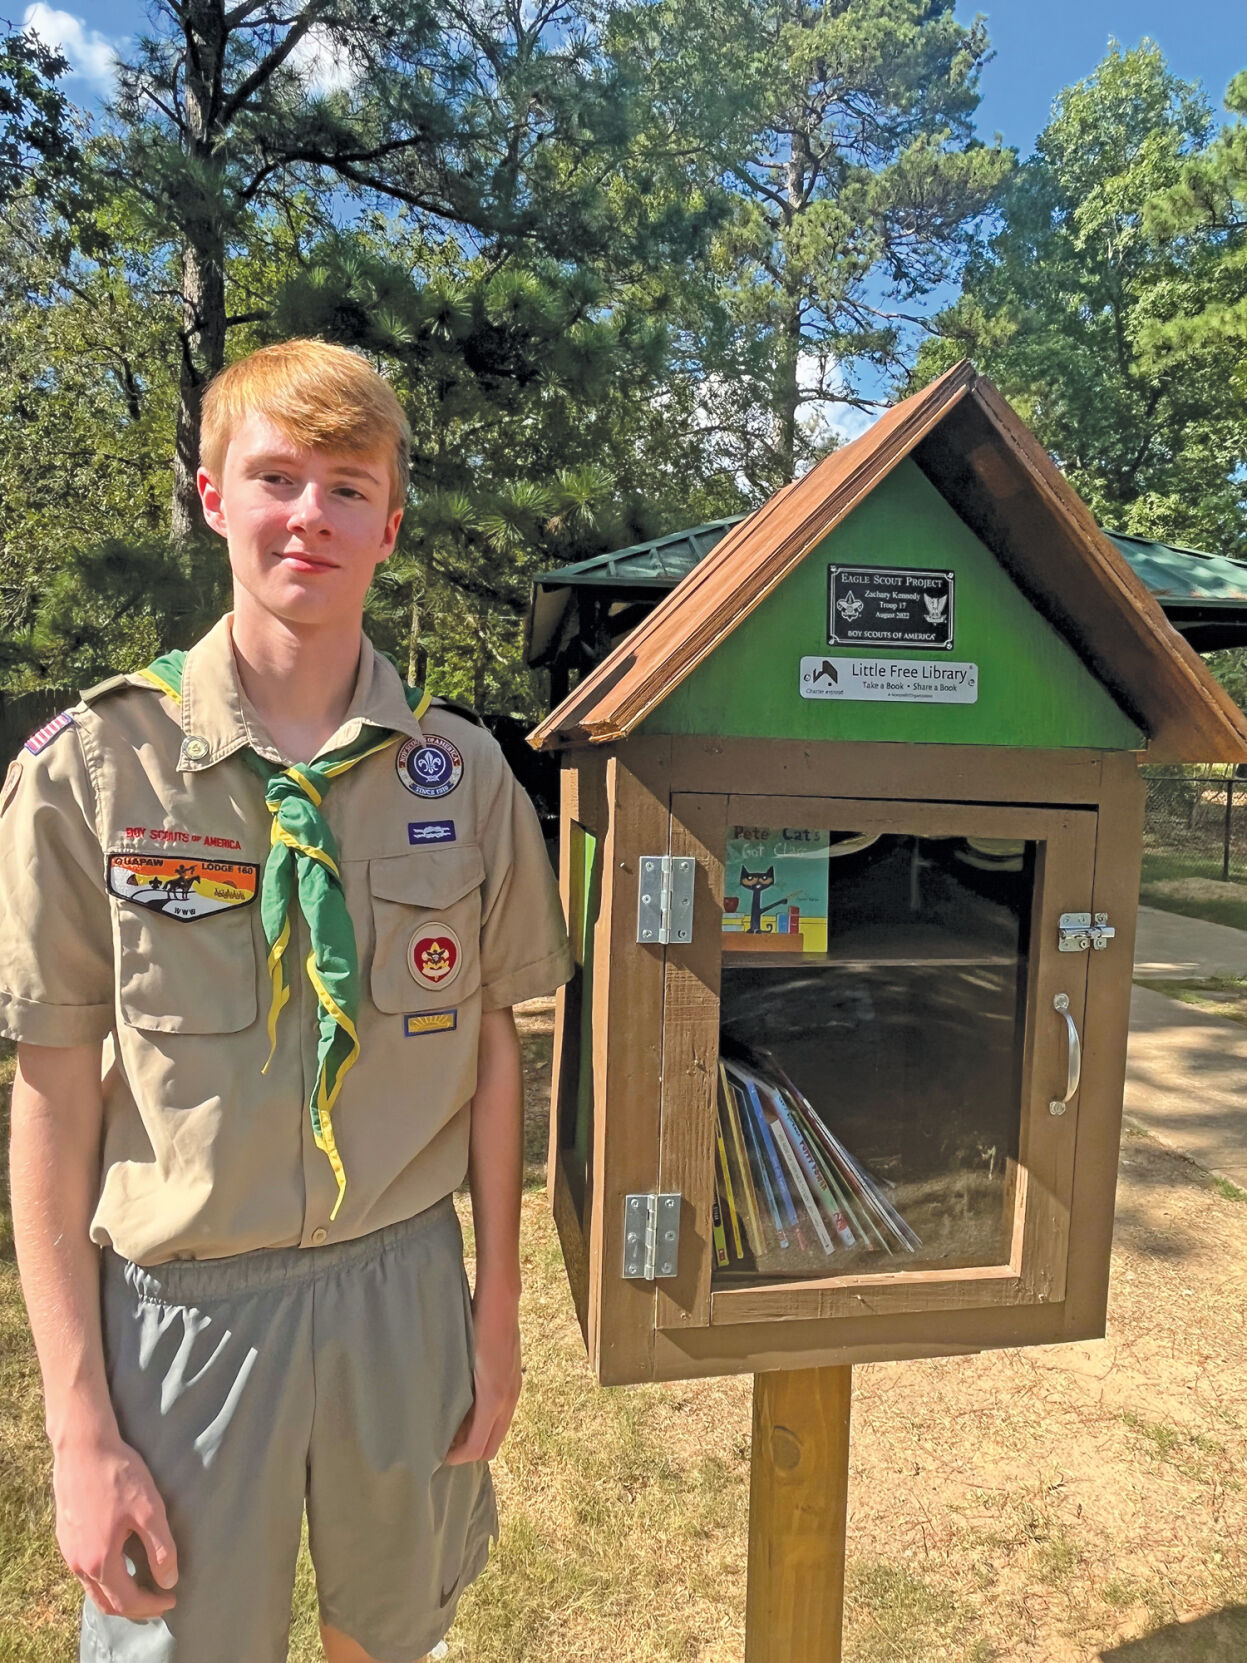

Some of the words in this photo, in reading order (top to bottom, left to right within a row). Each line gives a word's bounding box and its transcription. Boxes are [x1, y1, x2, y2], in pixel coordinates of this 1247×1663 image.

[841, 573, 870, 584] EAGLE
[873, 575, 903, 586] SCOUT
[906, 576, 943, 588] PROJECT
[864, 590, 890, 600] Zachary
[892, 592, 920, 600] Kennedy
[879, 601, 898, 610] Troop
[875, 611, 895, 619] August
[847, 630, 862, 638] BOY
[863, 631, 892, 639] SCOUTS
[903, 633, 936, 641] AMERICA
[852, 662, 886, 677] Little
[890, 666, 918, 679] Free
[922, 666, 967, 684] Library
[862, 681, 879, 689] Take
[886, 682, 904, 690] Book
[913, 683, 932, 691] Share
[940, 684, 957, 692] Book
[435, 738, 459, 762] AMERICA
[415, 786, 436, 796] SINCE
[125, 827, 146, 838] BOY
[149, 829, 190, 843] SCOUTS
[203, 835, 241, 850] AMERICA
[733, 825, 769, 840] Pete
[114, 856, 164, 867] QUAPAW
[201, 862, 233, 873] LODGE
[237, 866, 253, 875] 160
